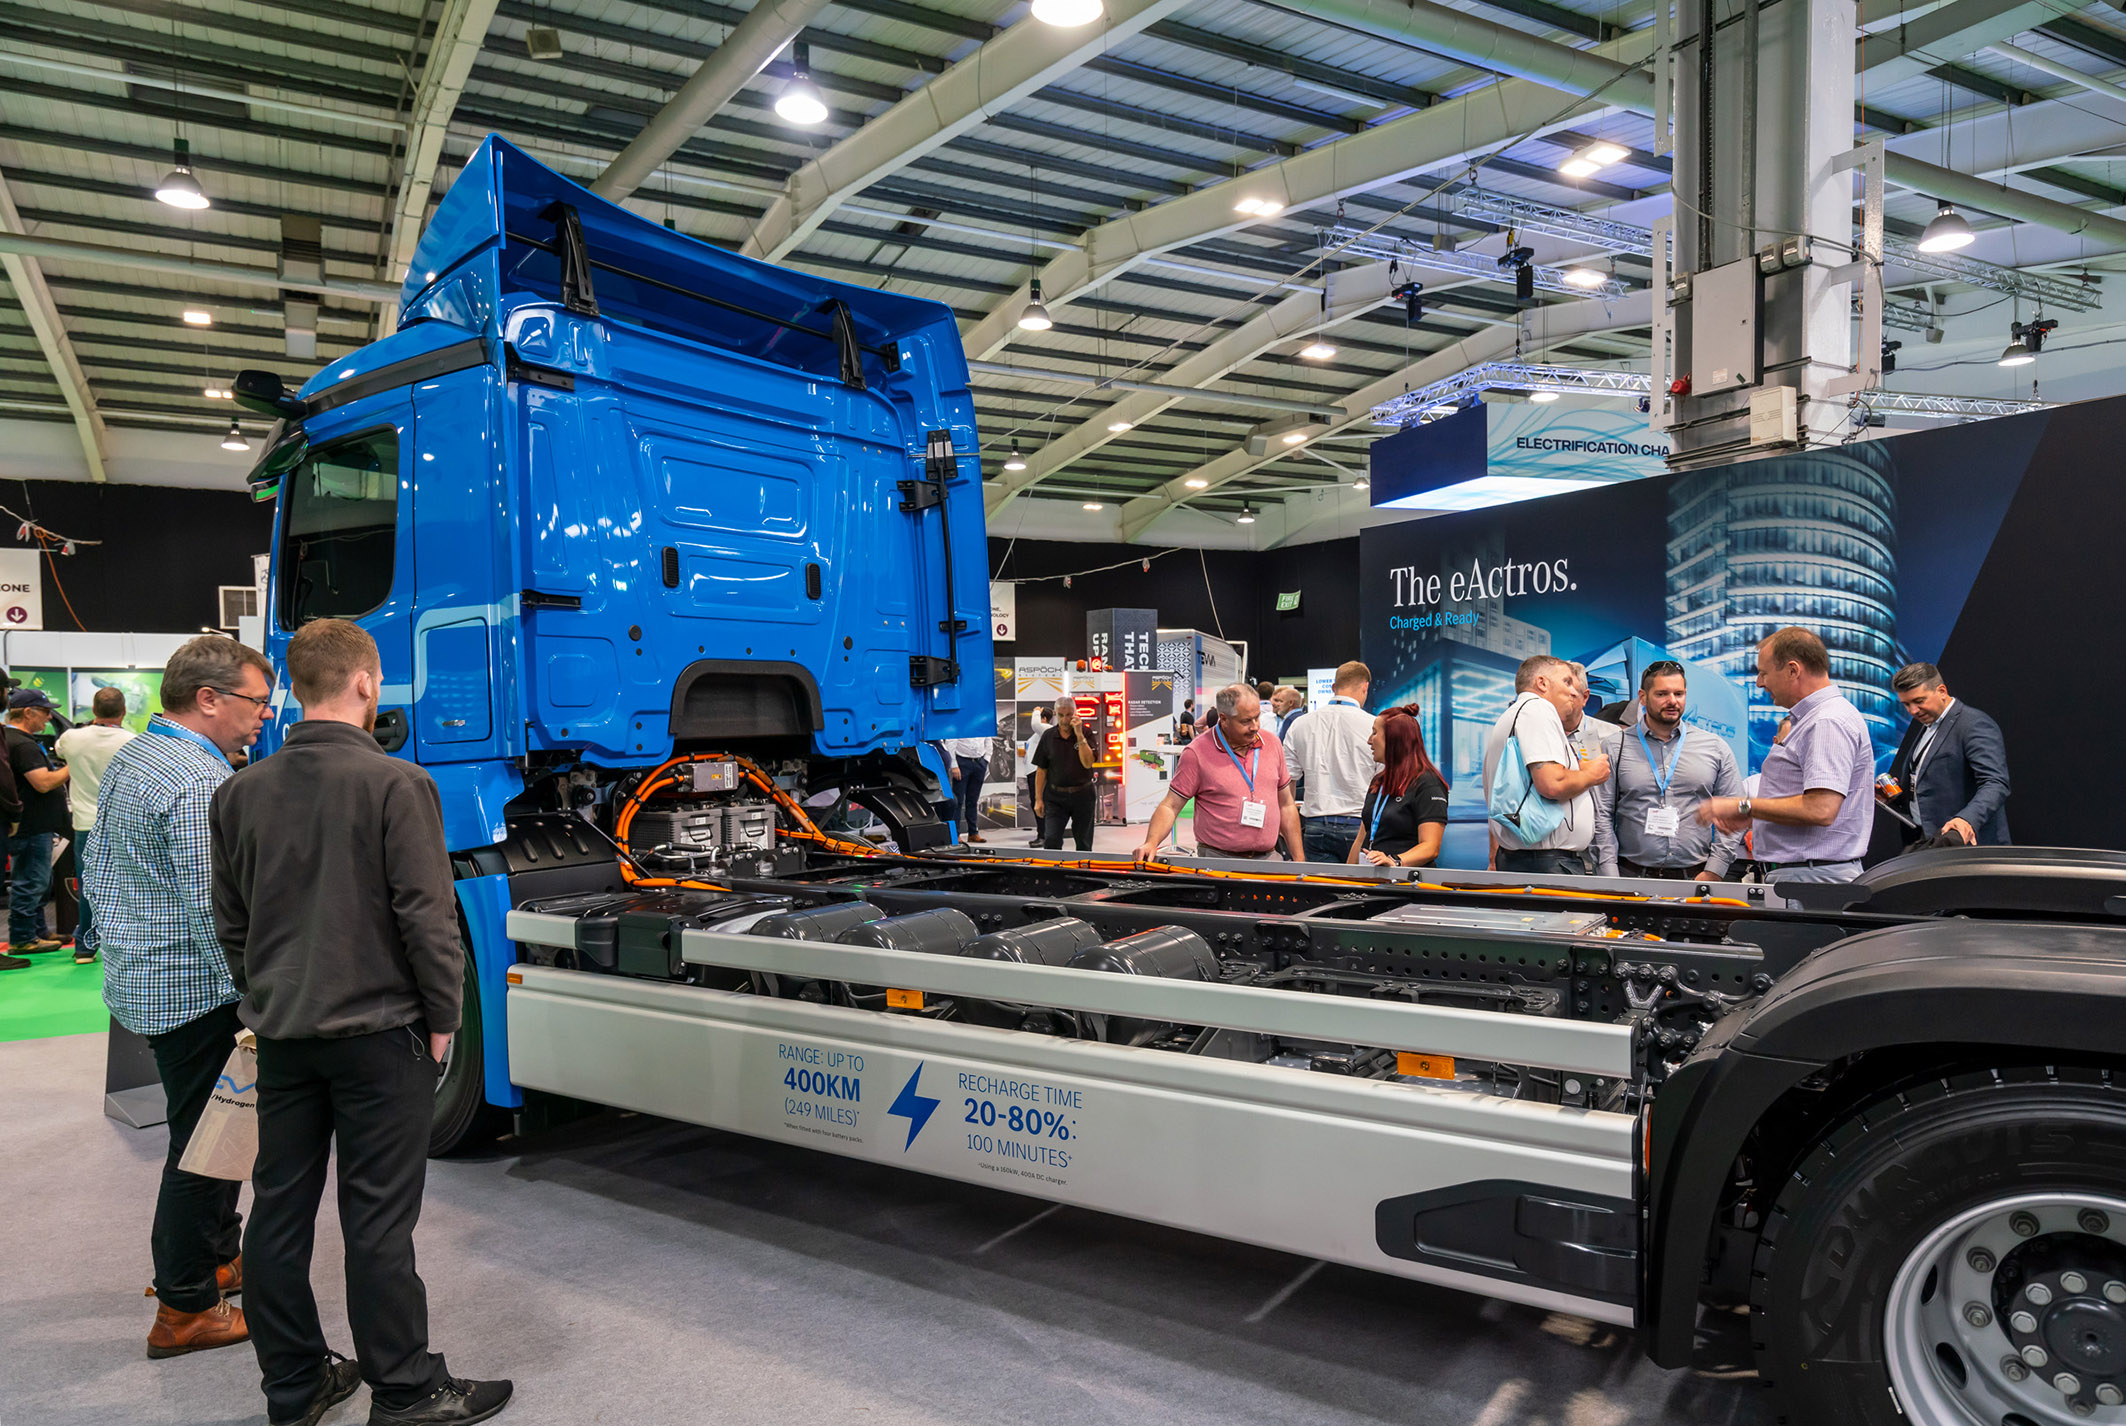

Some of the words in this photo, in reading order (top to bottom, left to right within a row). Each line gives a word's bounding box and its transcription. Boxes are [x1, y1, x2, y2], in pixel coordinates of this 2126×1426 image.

[1516, 437, 1638, 455] ELECTRIFICATION
[0, 584, 30, 592] ONE
[1389, 565, 1441, 607] The
[1450, 557, 1578, 602] eActros.
[1390, 611, 1433, 631] Charged
[1434, 612, 1443, 626] &
[1445, 609, 1480, 627] Ready
[779, 1043, 824, 1065] RANGE:
[827, 1050, 845, 1069] UP
[846, 1053, 865, 1072] TO
[783, 1066, 860, 1103] 400KM
[958, 1072, 1040, 1102] RECHARGE
[1043, 1086, 1083, 1110] TIME
[784, 1096, 812, 1117] (249
[964, 1097, 1077, 1141] 20-80%:
[967, 1133, 993, 1153] 100
[1036, 1173, 1045, 1181] DC
